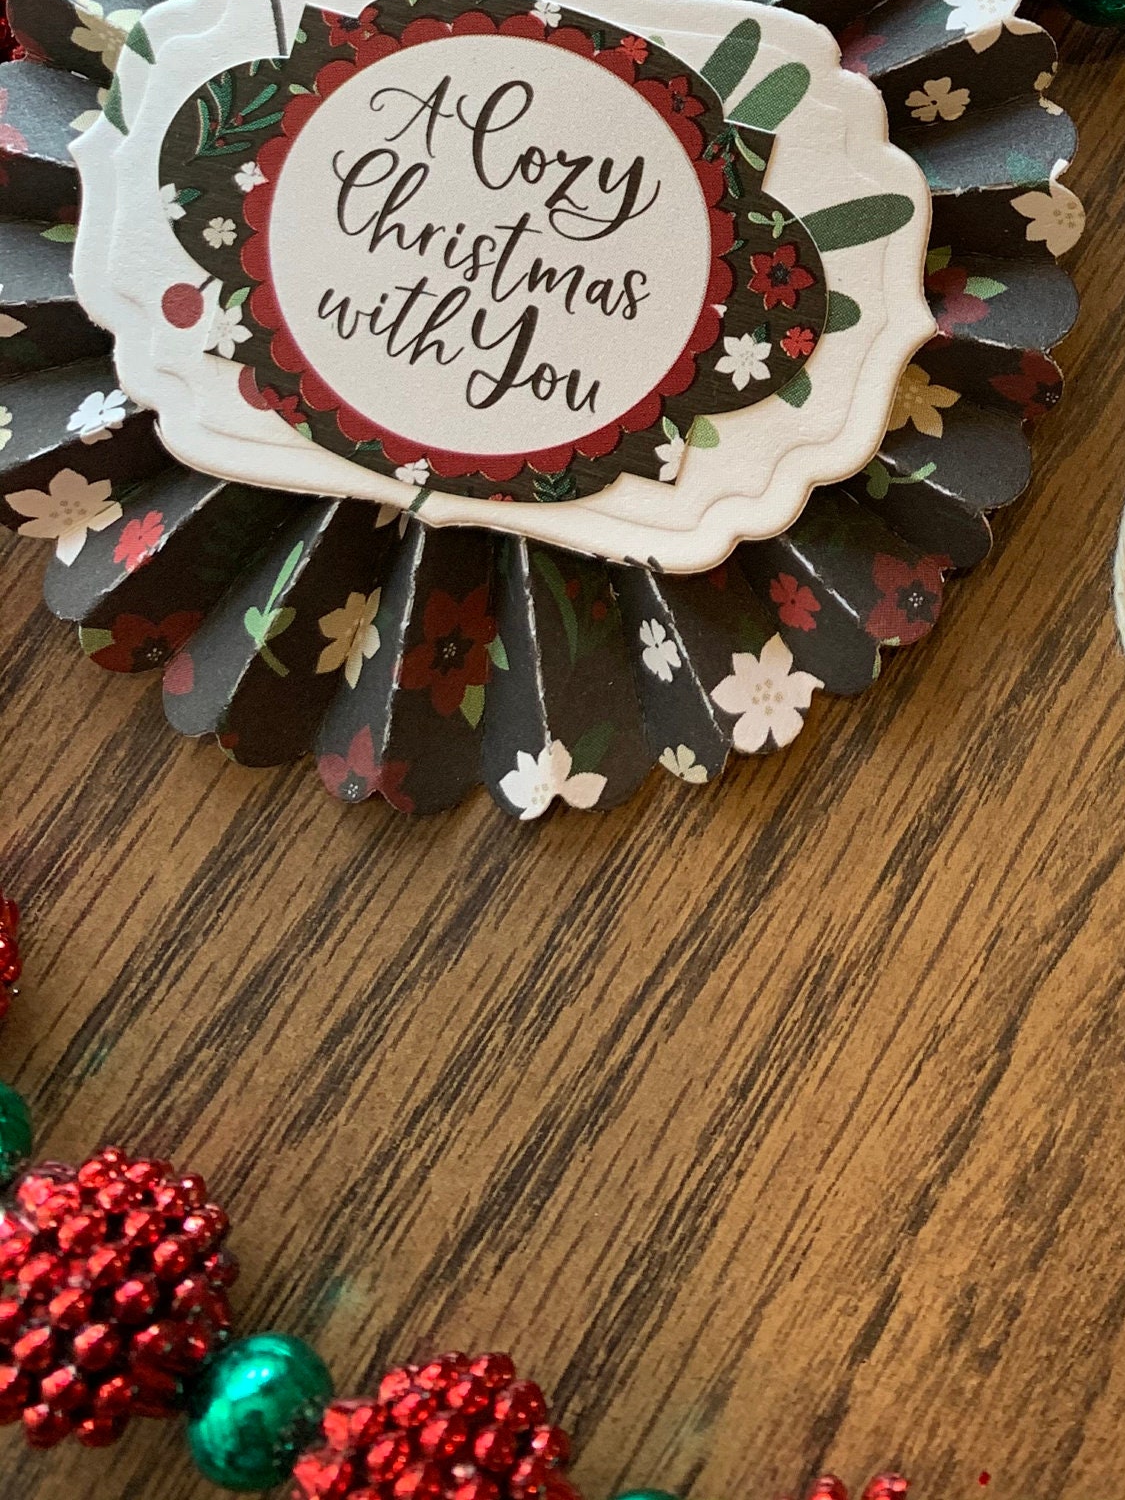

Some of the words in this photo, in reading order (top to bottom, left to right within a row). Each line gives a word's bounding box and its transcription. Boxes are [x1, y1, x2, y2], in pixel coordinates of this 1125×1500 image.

[332, 148, 651, 320] Christmas
[369, 75, 454, 158] A
[457, 80, 661, 241] Cozy
[318, 277, 471, 366] with
[466, 305, 600, 413] You
